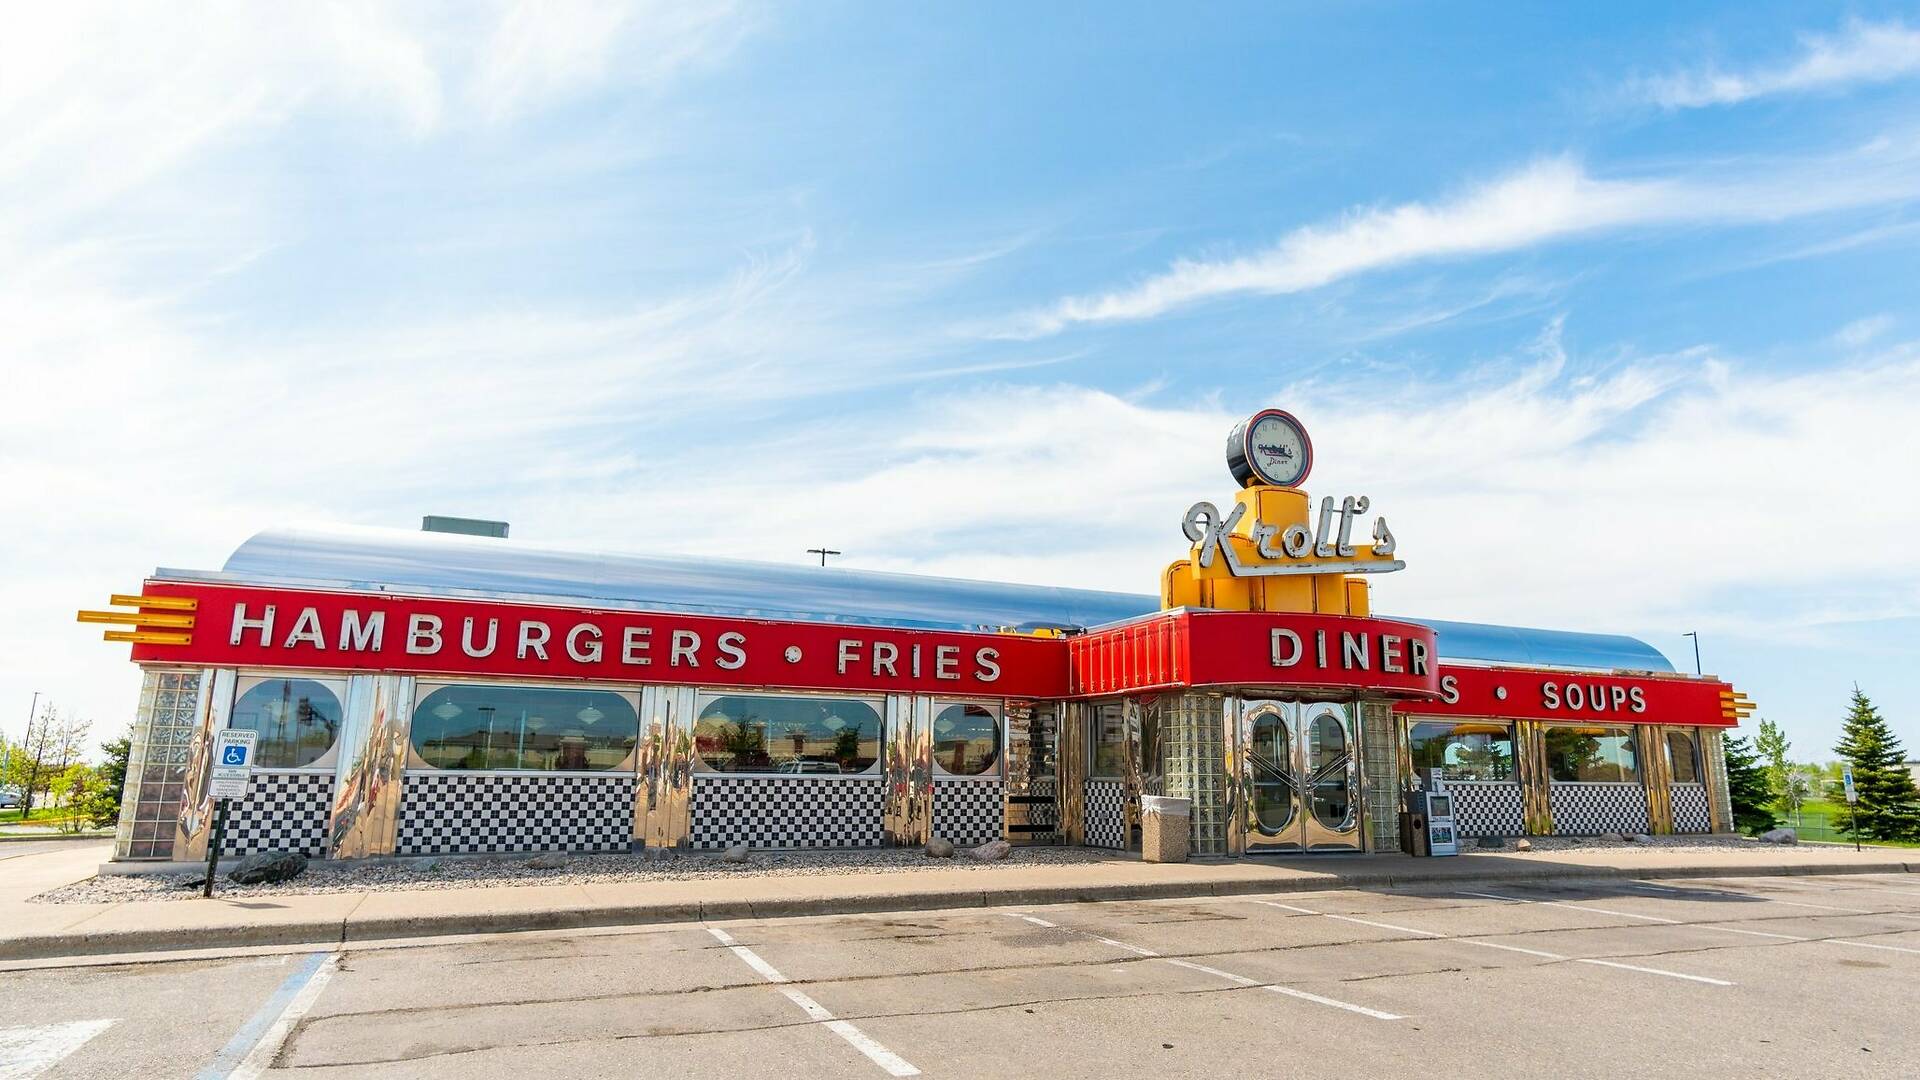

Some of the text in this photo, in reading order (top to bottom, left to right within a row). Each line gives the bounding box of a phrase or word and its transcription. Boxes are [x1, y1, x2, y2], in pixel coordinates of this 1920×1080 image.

[1182, 495, 1406, 577] Kroll's
[229, 602, 1001, 682] HAMBURGERS FRIES
[1270, 627, 1429, 676] DINER
[1543, 681, 1647, 713] SOUPS
